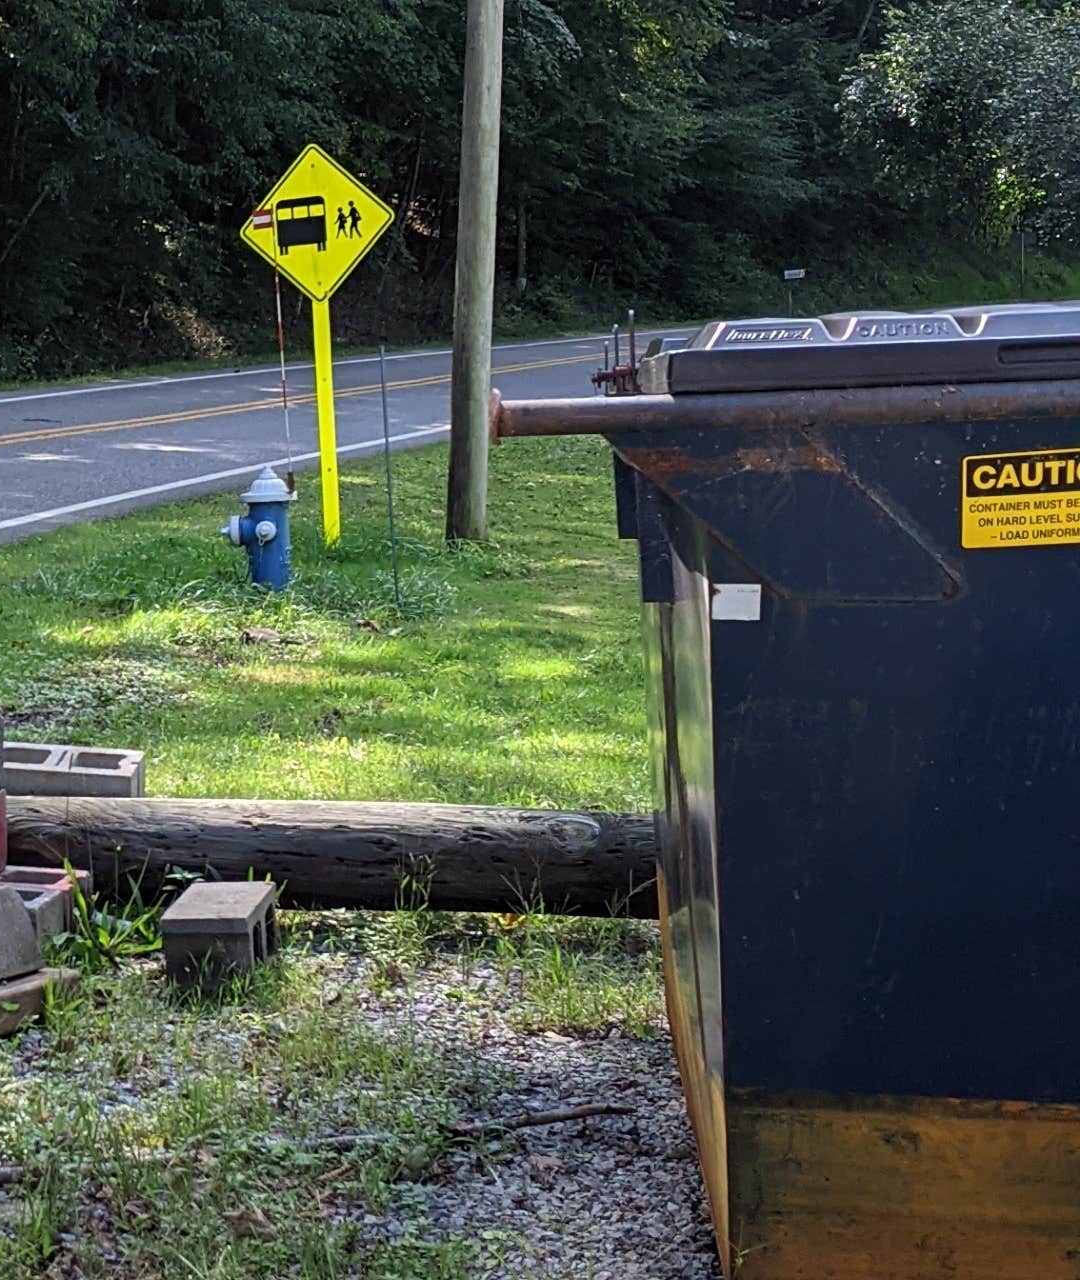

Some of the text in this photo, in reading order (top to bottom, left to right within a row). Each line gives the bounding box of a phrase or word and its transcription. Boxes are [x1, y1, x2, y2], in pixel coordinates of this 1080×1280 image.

[858, 322, 950, 338] CAUTION
[973, 460, 1080, 489] CAUTI
[969, 501, 1031, 514] CONTAINER
[1033, 500, 1063, 511] MUST
[978, 517, 993, 527] ON
[996, 516, 1027, 527] HARD
[1029, 514, 1063, 525] LEVEL
[1000, 529, 1029, 540] LOAD
